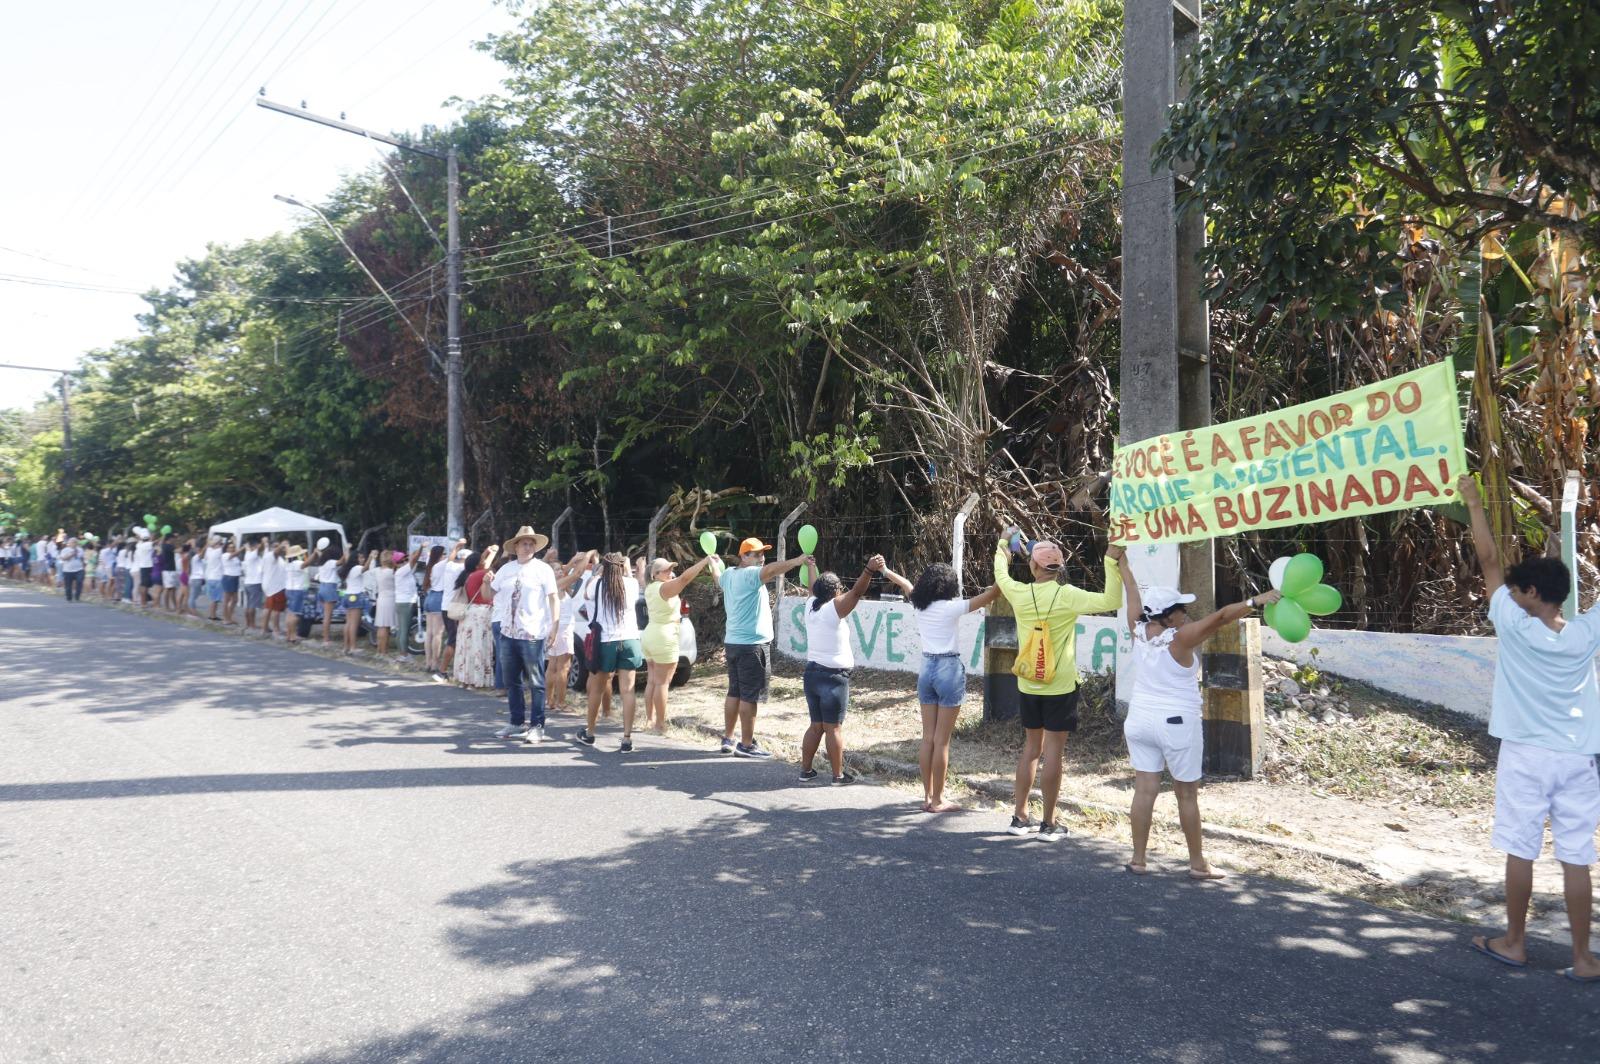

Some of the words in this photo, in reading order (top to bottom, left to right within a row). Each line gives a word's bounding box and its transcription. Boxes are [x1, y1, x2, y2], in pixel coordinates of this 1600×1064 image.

[1125, 436, 1179, 479] VOCÊ
[1182, 431, 1204, 472] É
[1211, 433, 1237, 467] A
[1238, 403, 1353, 460] FAVOR
[1366, 381, 1422, 421] DO
[1110, 478, 1195, 514] ARQUE
[1144, 502, 1208, 540] UMA
[1213, 457, 1455, 529] BUZINADA!
